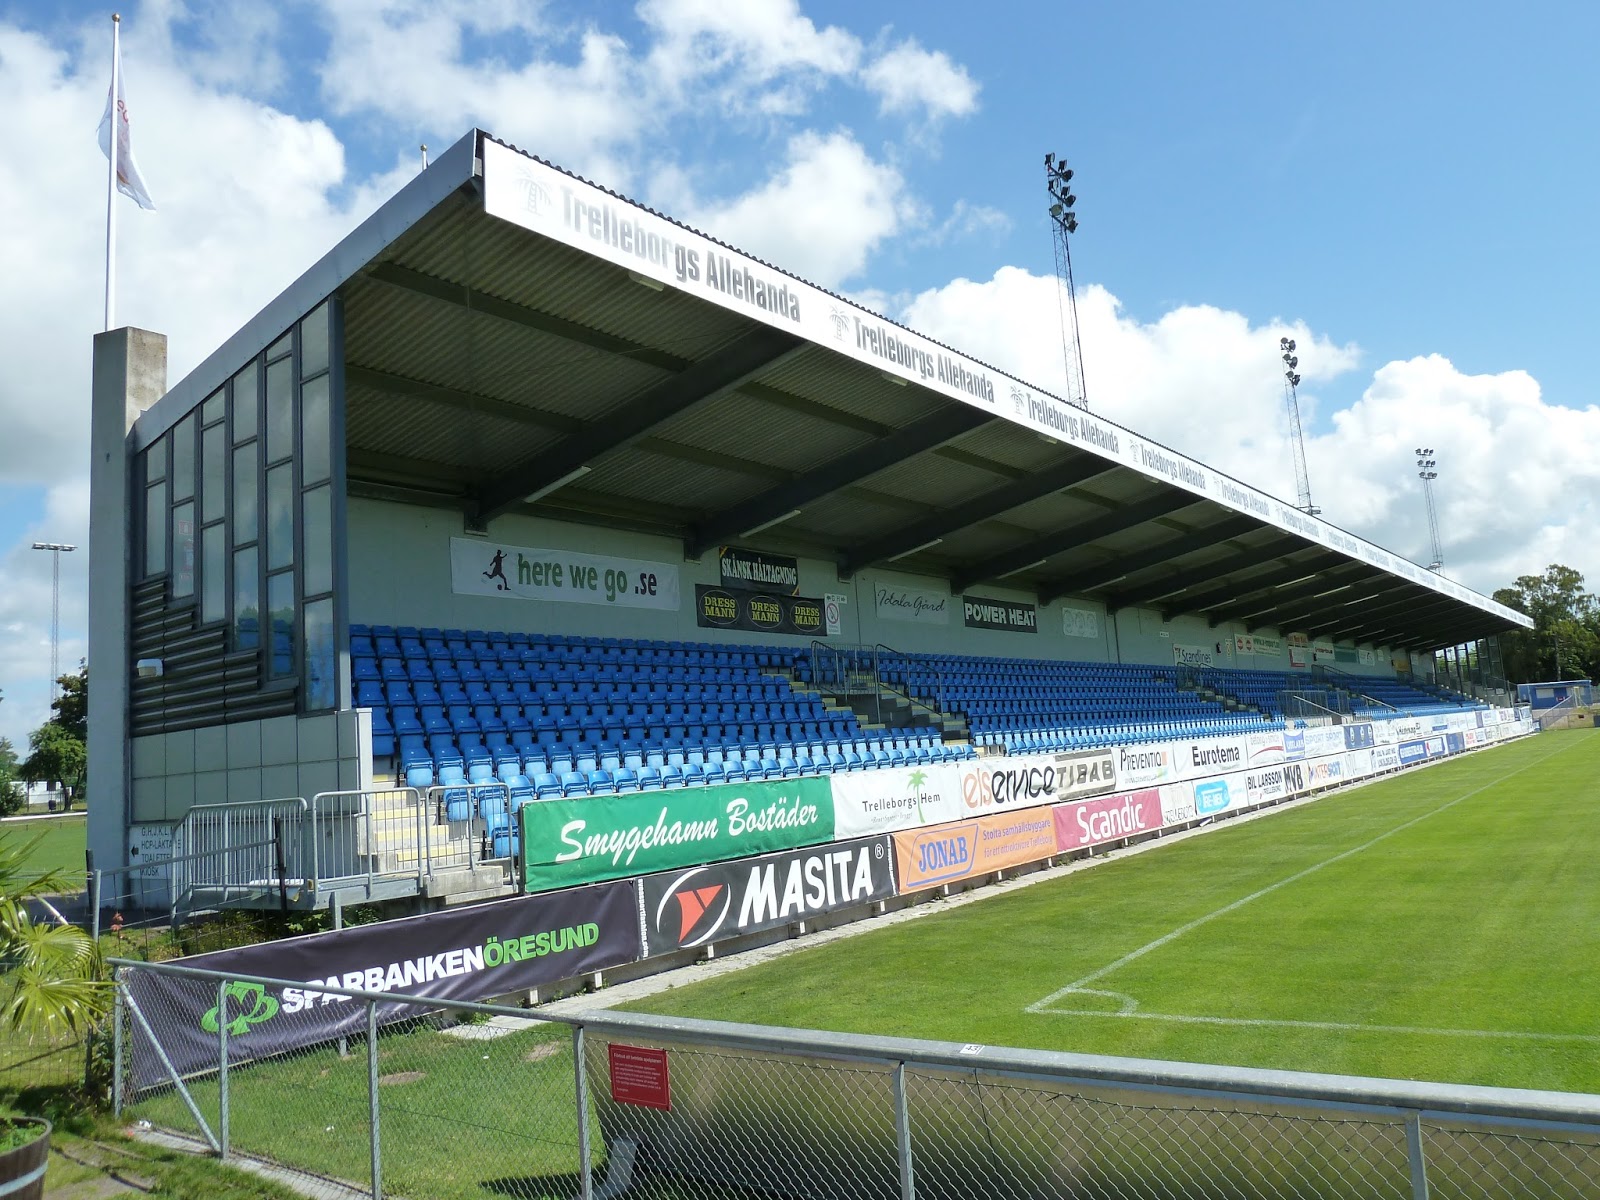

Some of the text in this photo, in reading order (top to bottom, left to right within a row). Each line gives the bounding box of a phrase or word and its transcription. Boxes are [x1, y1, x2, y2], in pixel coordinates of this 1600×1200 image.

[559, 185, 801, 324] Trelleborgs Allehanda
[853, 316, 995, 404] Trelleborgs Allehanda
[1026, 393, 1120, 454] Trelleborgs Allehanda
[518, 553, 657, 602] here we go .se
[721, 553, 797, 585] SKÅNSK HÅLTAGNING
[704, 596, 736, 609] DRESS
[704, 606, 736, 618] MANN
[751, 601, 779, 613] DRESS
[794, 606, 820, 617] DRESS
[913, 596, 945, 616] Gård
[965, 602, 1036, 627] POWER HEAT
[751, 611, 780, 622] MANN
[795, 615, 820, 626] MANN
[1192, 745, 1240, 767] Eurotema
[963, 764, 1057, 809] elservice
[1056, 759, 1113, 788] TIBAB
[1247, 770, 1283, 790] BIL LARSSON
[1283, 764, 1304, 794] MVB
[862, 792, 941, 812] Trelleborgs Hem
[555, 796, 818, 866] Smygehamn Bostäder
[983, 828, 1001, 840] Stolta
[1077, 797, 1146, 844] Scandic
[918, 836, 969, 873] JONAB
[738, 846, 874, 928] MASITA
